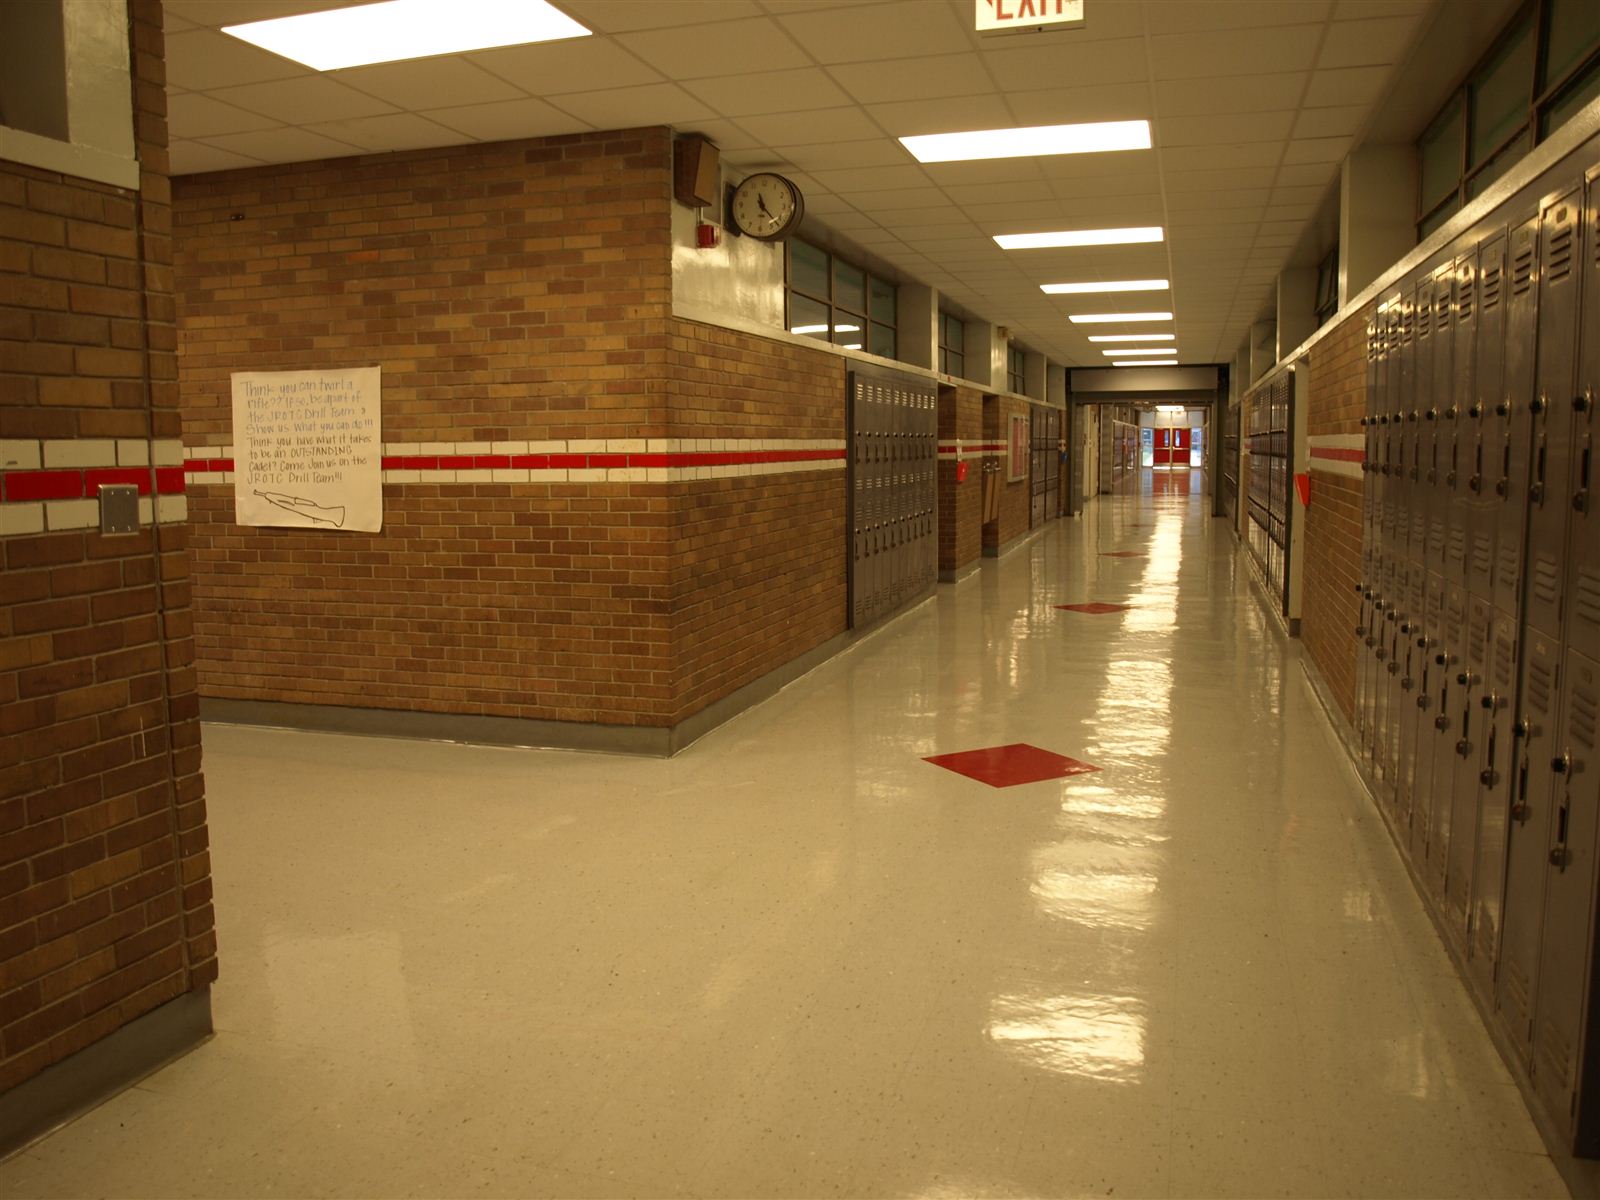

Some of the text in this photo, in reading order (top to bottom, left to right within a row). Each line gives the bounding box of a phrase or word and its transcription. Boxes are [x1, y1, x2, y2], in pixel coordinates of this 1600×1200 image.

[240, 381, 273, 397] Think
[280, 383, 296, 398] you
[299, 381, 316, 391] can
[319, 377, 344, 391] twirl
[247, 410, 265, 423] the
[304, 406, 326, 419] Drill
[278, 424, 290, 433] us
[320, 421, 334, 434] you
[336, 421, 350, 431] can
[246, 436, 272, 449] Think
[276, 436, 292, 450] you
[296, 435, 314, 446] have
[339, 432, 346, 444] it
[349, 433, 372, 444] takes
[247, 445, 353, 461] to be an OUTSTANDING
[326, 459, 337, 468] us
[338, 457, 350, 467] on
[352, 455, 369, 466] the
[246, 471, 283, 485] JROTC
[288, 471, 310, 483] Drill
